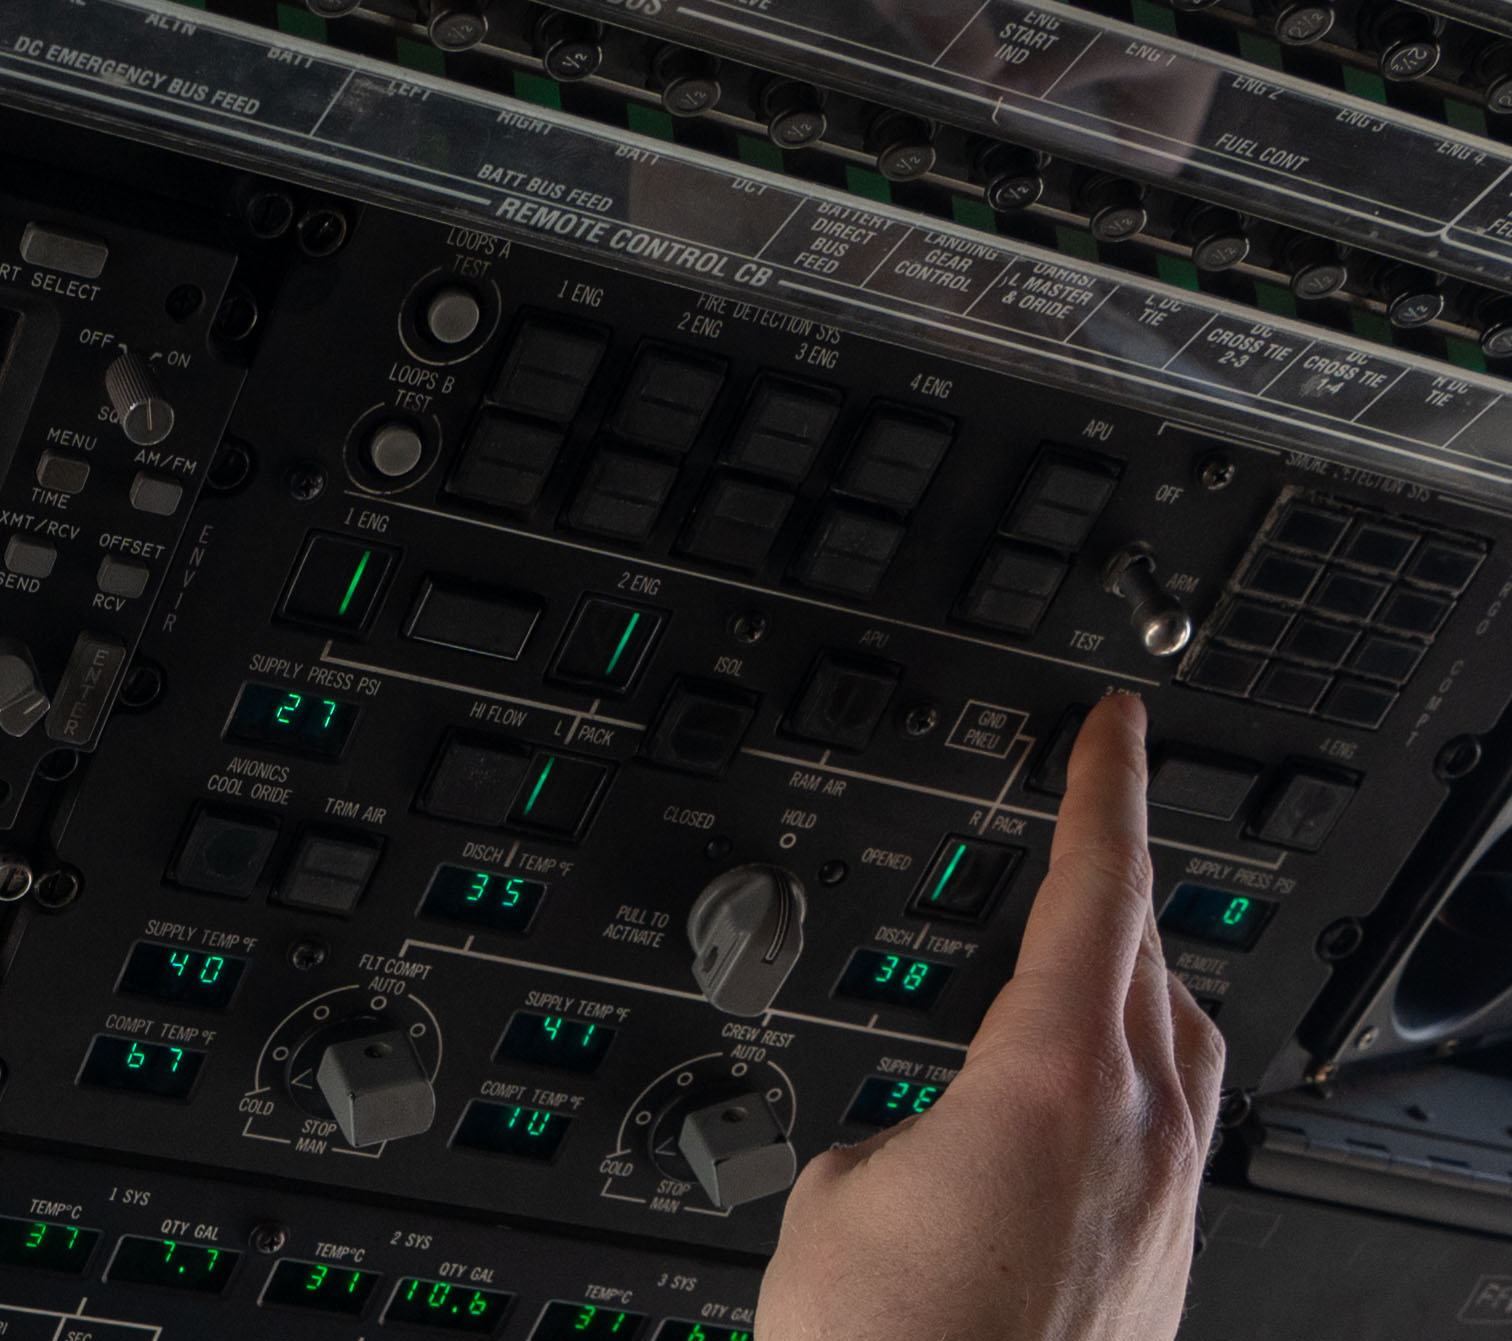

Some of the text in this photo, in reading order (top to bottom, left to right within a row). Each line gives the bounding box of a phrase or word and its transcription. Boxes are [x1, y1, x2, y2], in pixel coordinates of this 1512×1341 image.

[14, 36, 261, 116] DC EMERGENCY BUS FEED
[1216, 132, 1310, 172] FUEL CONT
[477, 164, 613, 213] BATT BUS FEED
[446, 228, 512, 260] LOOPS A
[496, 198, 772, 288] REMOTE CONTROL CB
[810, 217, 876, 248] DIRECT
[794, 250, 839, 275] FEED
[809, 238, 847, 259] BUS
[925, 248, 973, 272] GEAR
[453, 254, 492, 279] TEST
[893, 260, 971, 294] CONTROL
[31, 269, 100, 303] SELECT
[557, 281, 605, 308] 1 ENG
[79, 327, 114, 351] OFF
[167, 349, 192, 370] ON
[388, 361, 455, 394] LOOPS B
[395, 389, 434, 412] TEST
[47, 426, 98, 451] MENU
[134, 449, 197, 476] AM/FM
[31, 488, 70, 511] TIME
[98, 532, 165, 560] OFFSET
[92, 592, 126, 615] RCV
[248, 652, 382, 698] SUPPLY PRESS PSI
[275, 694, 338, 728] 27
[226, 754, 291, 783] AVIONICS
[207, 774, 245, 798] COOL
[324, 796, 387, 825] TRIM AIR
[664, 804, 715, 831] CLOSED
[465, 873, 525, 908] 35
[615, 904, 670, 928] PULL TO
[602, 921, 665, 949] ACTIVATE
[168, 952, 224, 986] 40
[358, 953, 432, 981] FLT COMPT
[368, 975, 406, 996] AUTO
[721, 1021, 795, 1049] CREW REST
[238, 1097, 274, 1118] COLD
[25, 1223, 80, 1251] 37
[160, 1219, 219, 1242] QTY GAL
[160, 1240, 220, 1276] 7.7
